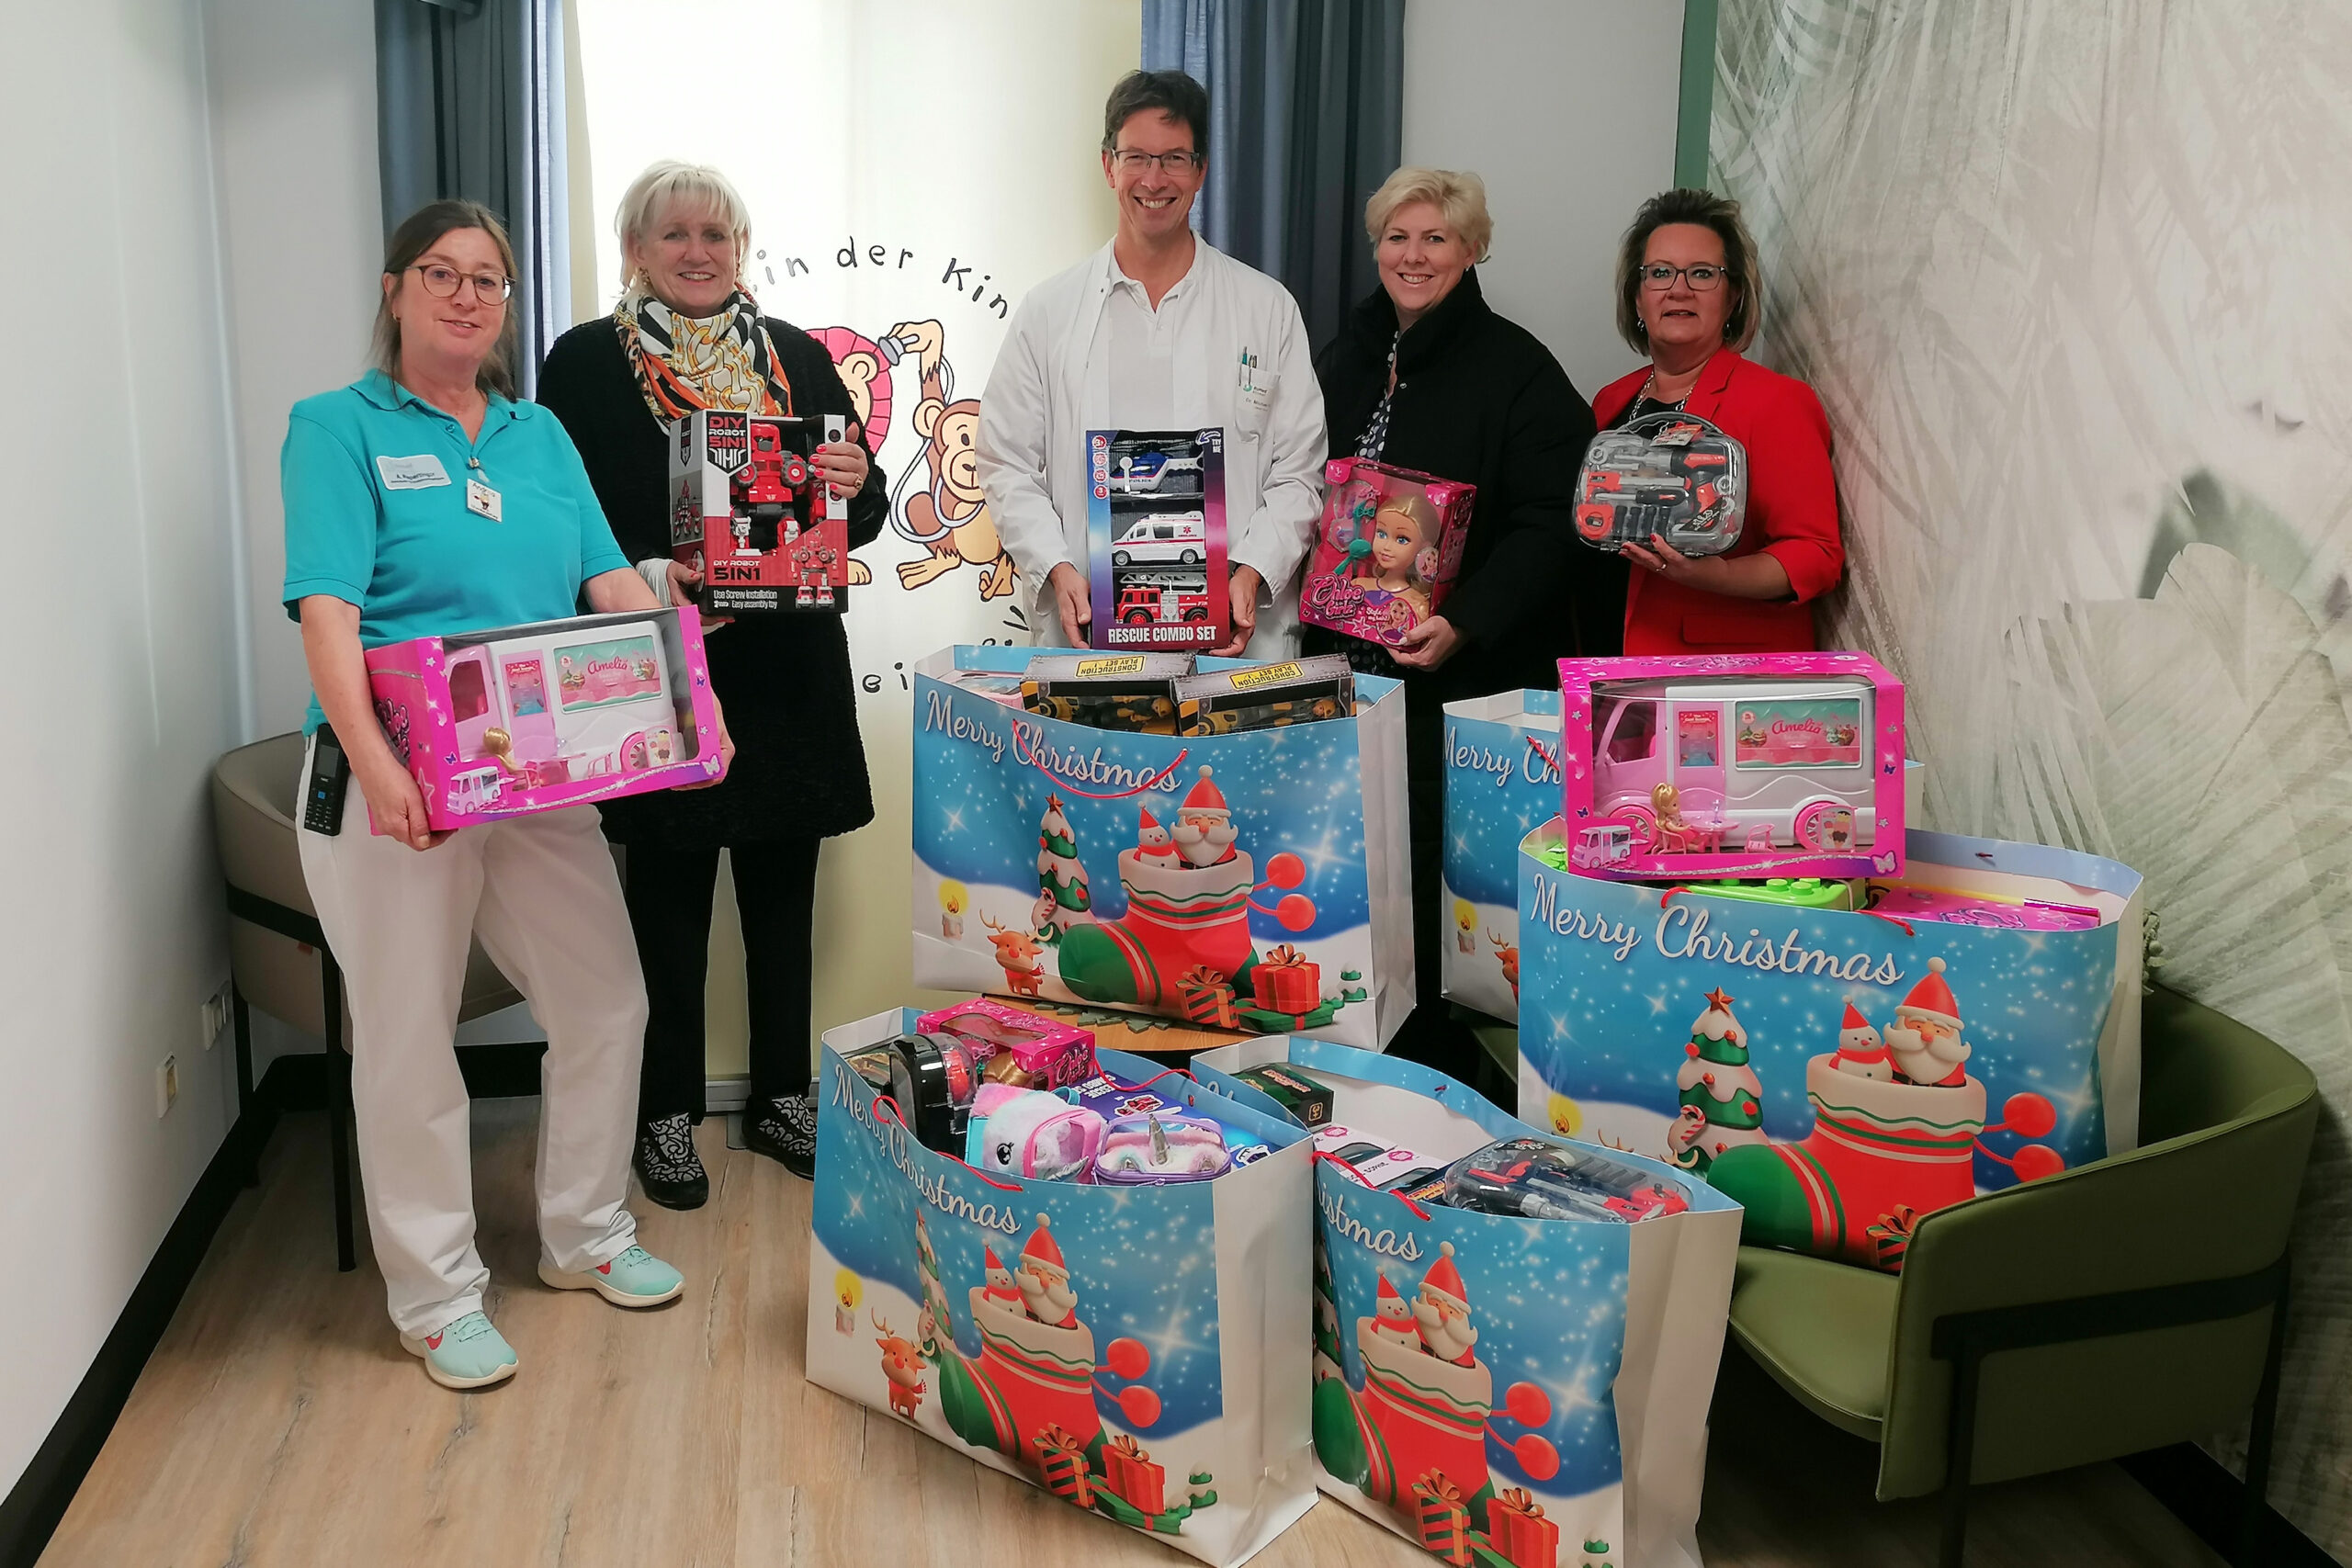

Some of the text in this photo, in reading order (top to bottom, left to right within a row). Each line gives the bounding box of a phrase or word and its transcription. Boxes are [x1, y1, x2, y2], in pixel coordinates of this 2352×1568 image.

[837, 235, 913, 268] der
[709, 416, 745, 429] DIY
[708, 436, 746, 448] 5IN1
[714, 568, 761, 581] 5IN1
[713, 590, 777, 600] Use Screw Installation
[1311, 574, 1364, 607] Chloe
[731, 600, 744, 610] Easy
[1108, 626, 1216, 643] RESCUE COMBO SET
[588, 656, 628, 675] Amelia
[1080, 664, 1137, 674] CONSTRUCTION
[1120, 658, 1138, 666] PLAY
[1274, 665, 1293, 674] PLAY
[1238, 671, 1296, 686] CONSTRUCTION
[1771, 718, 1823, 735] Amelia
[924, 689, 1182, 792] Merry Christmas
[1530, 873, 1905, 987] Merry Christmas
[832, 1063, 1022, 1235] Merry Christmas
[1317, 1177, 1424, 1261] istmas
